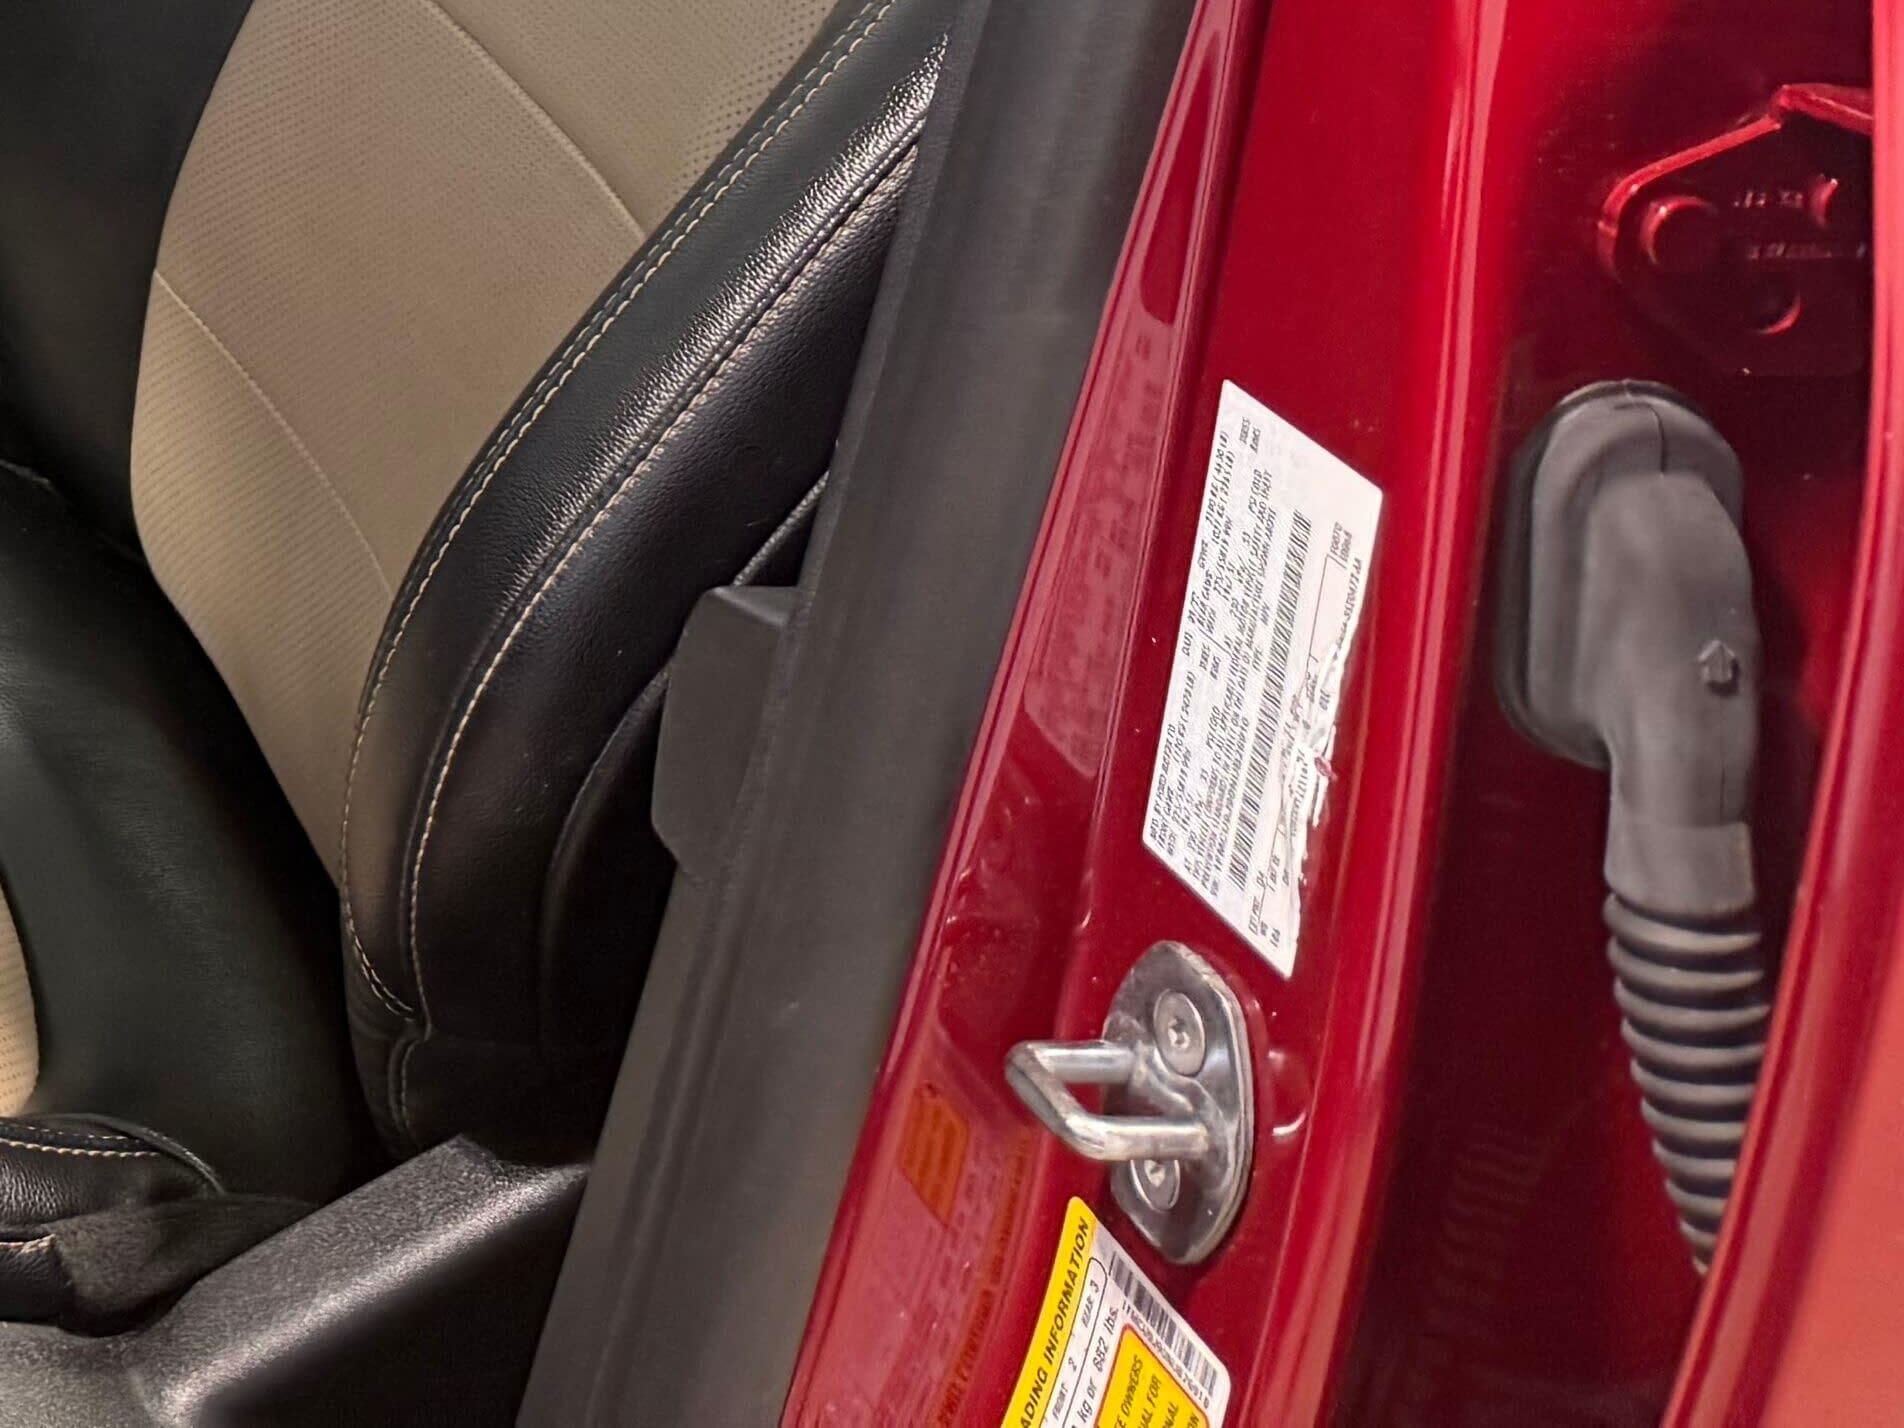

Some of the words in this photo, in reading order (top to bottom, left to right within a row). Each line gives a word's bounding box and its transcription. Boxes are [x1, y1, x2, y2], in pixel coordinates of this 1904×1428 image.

[1044, 1216, 1089, 1365] INFORMATION
[1077, 1400, 1092, 1423] kg
[1087, 1376, 1097, 1399] or
[1147, 1373, 1162, 1408] FOR
